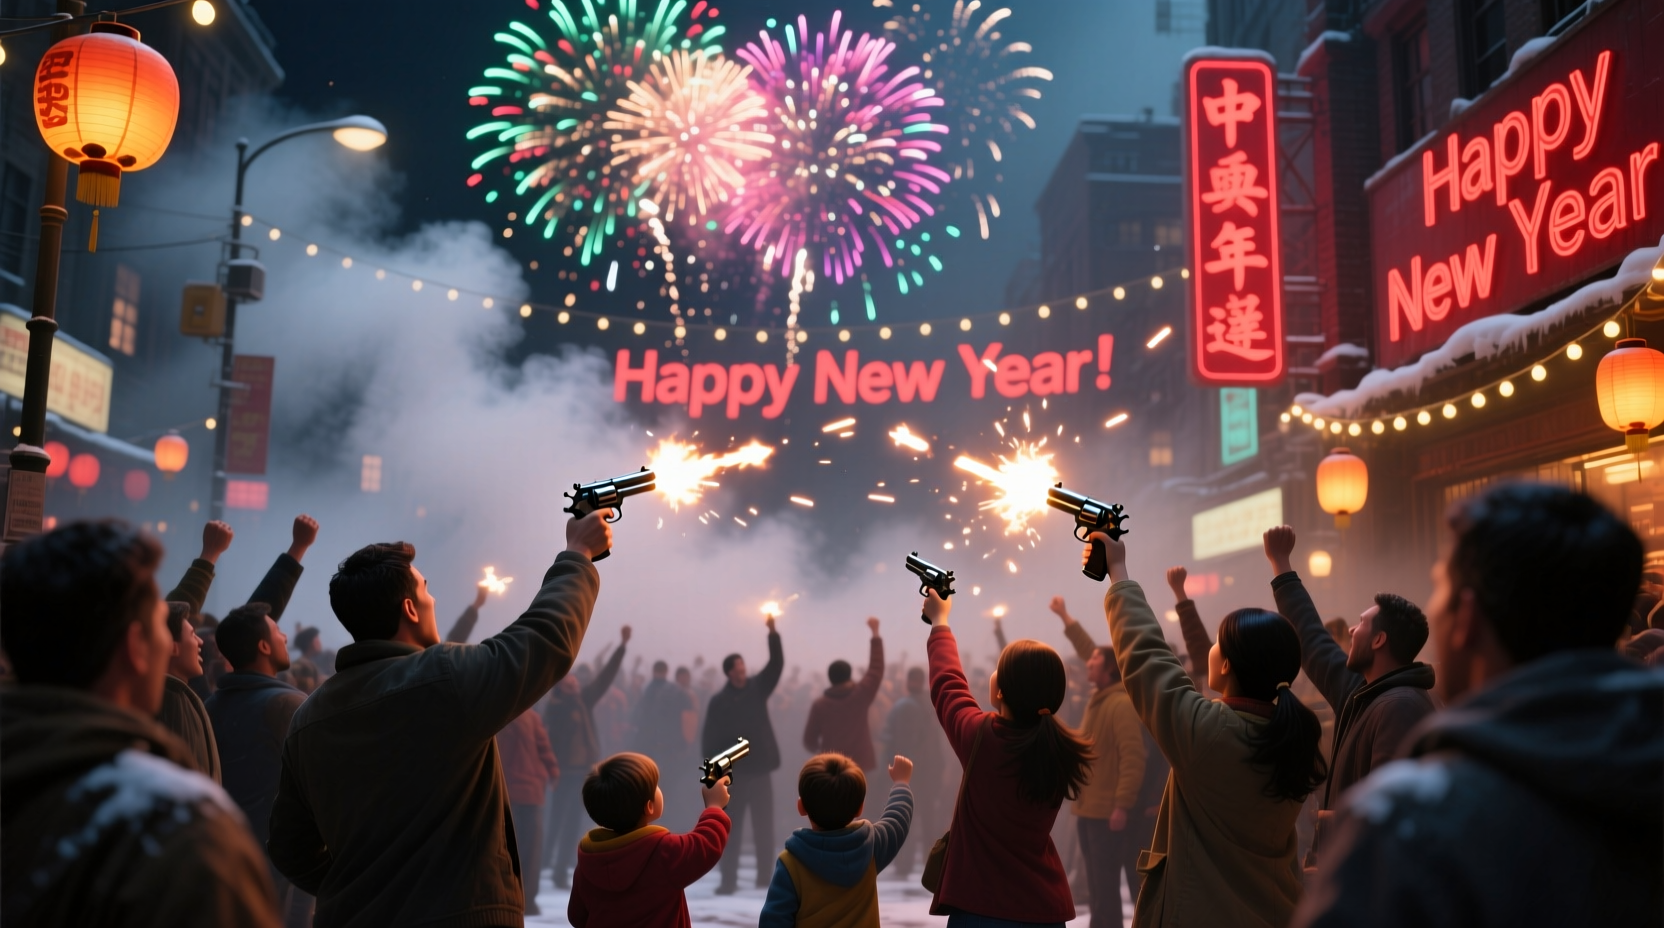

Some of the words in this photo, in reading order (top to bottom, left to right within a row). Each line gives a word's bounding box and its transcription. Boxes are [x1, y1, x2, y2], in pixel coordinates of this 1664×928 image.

[1422, 49, 1611, 227] Happy
[1387, 233, 1497, 342] New
[1508, 142, 1659, 275] Year
[613, 348, 800, 420] Happy
[813, 348, 946, 405] New
[957, 333, 1115, 400] Year!
